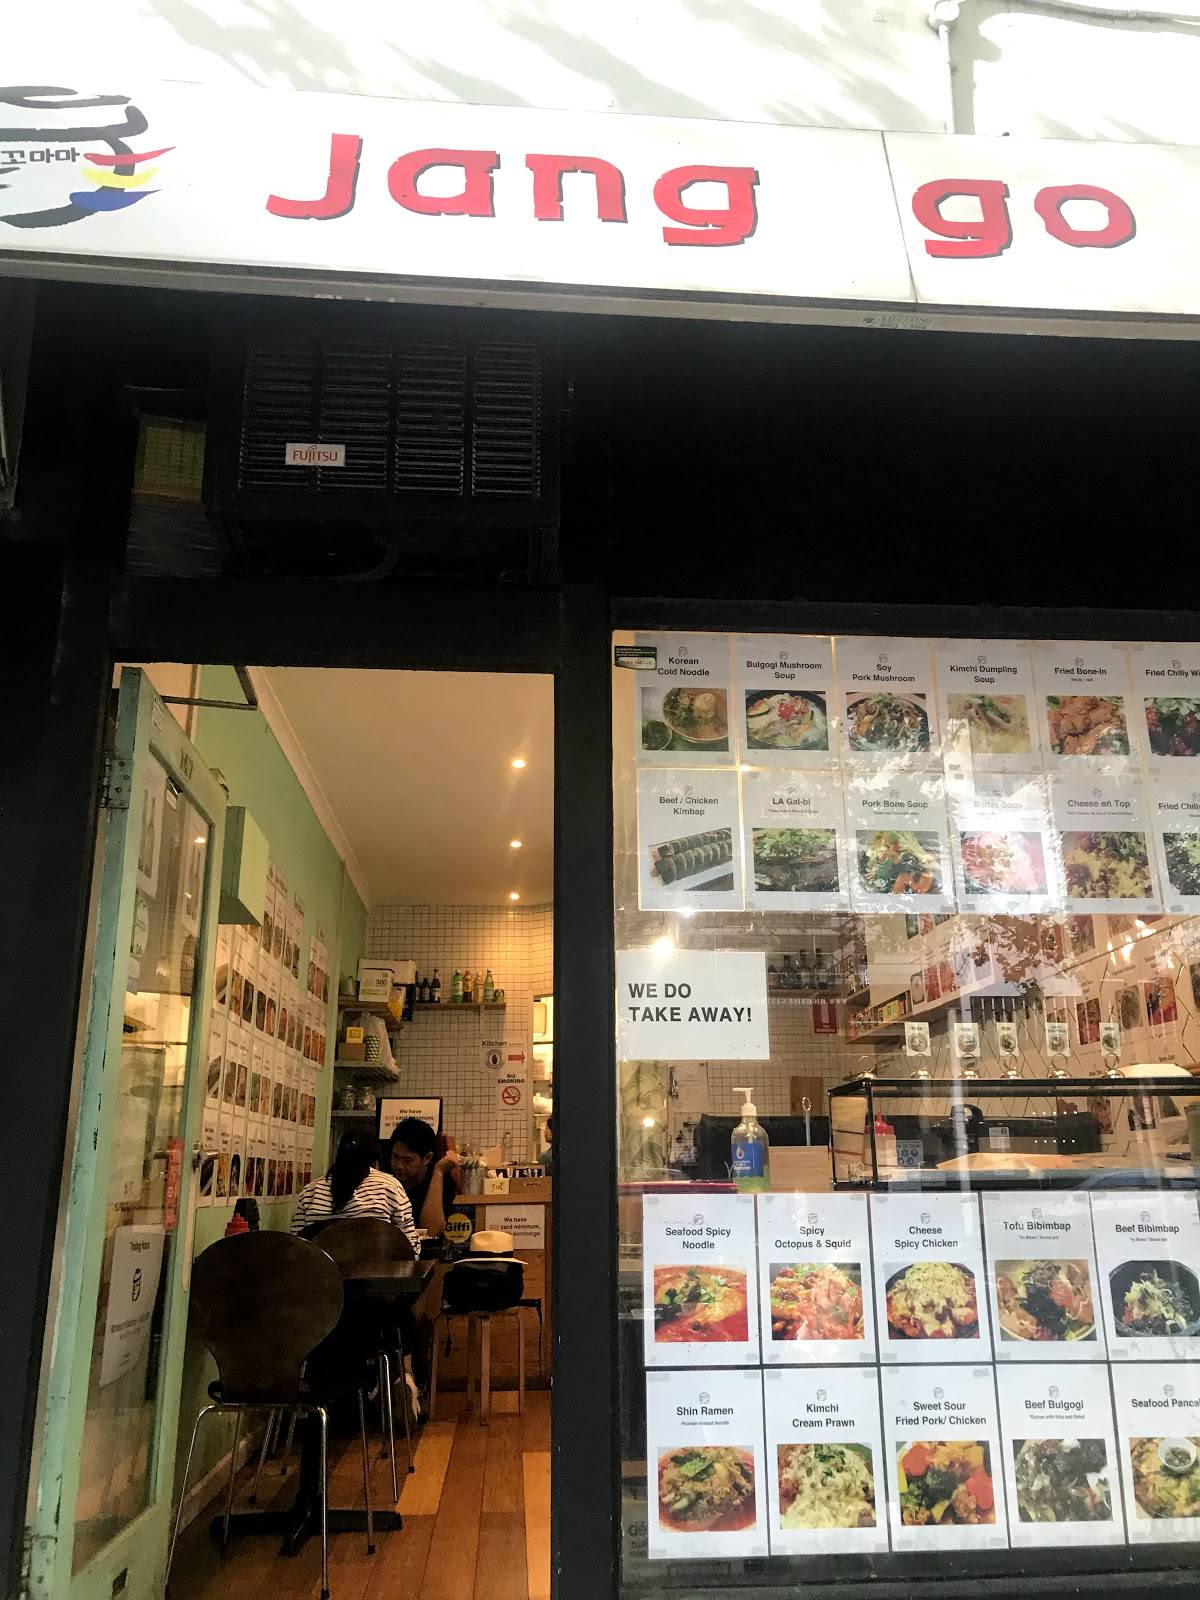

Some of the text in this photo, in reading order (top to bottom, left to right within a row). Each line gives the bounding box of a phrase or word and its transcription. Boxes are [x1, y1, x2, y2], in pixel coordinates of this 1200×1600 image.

[266, 133, 1137, 260] Jang go
[293, 445, 338, 463] FUJITSU
[668, 657, 699, 665] Korean
[746, 661, 822, 670] Bulgogi Mushroom
[657, 668, 678, 676] Cold
[876, 664, 892, 672] Soy
[950, 665, 1018, 675] Kimchi Dumpling
[774, 672, 796, 680] Soup
[1145, 669, 1165, 677] Fried
[1167, 670, 1189, 678] Chilly
[873, 675, 916, 683] Mushroom
[974, 676, 995, 684] Soup
[659, 796, 678, 804] Beef
[685, 797, 719, 805] Chicken
[772, 797, 811, 806] LA Gal-bi
[907, 801, 929, 809] Soup
[1067, 800, 1099, 808] Cheese
[1113, 800, 1131, 809] Top
[673, 807, 705, 816] Kimbap
[628, 983, 692, 999] WE DO
[628, 1006, 752, 1023] TAKE AWAY!
[799, 1226, 826, 1237] Spicy
[909, 1226, 943, 1235] Cheese
[1003, 1221, 1072, 1233] Tofu Bibimbap
[1115, 1224, 1180, 1234] Beef Bibimbap
[665, 1226, 732, 1239] Seafood Spicy
[682, 1241, 715, 1250] Noodle
[774, 1239, 852, 1250] Octopus & Squid
[894, 1239, 959, 1250] Spicy Chicken
[913, 1401, 966, 1411] Sweet Sour
[1025, 1400, 1084, 1411] Beef Bulgogi
[1131, 1399, 1169, 1408] Seafood
[676, 1406, 734, 1416] Shin Ramen
[806, 1404, 839, 1413] Kimchi
[792, 1418, 855, 1428] Cream Prawn
[895, 1416, 920, 1426] Fried
[949, 1416, 987, 1425] Chicken
